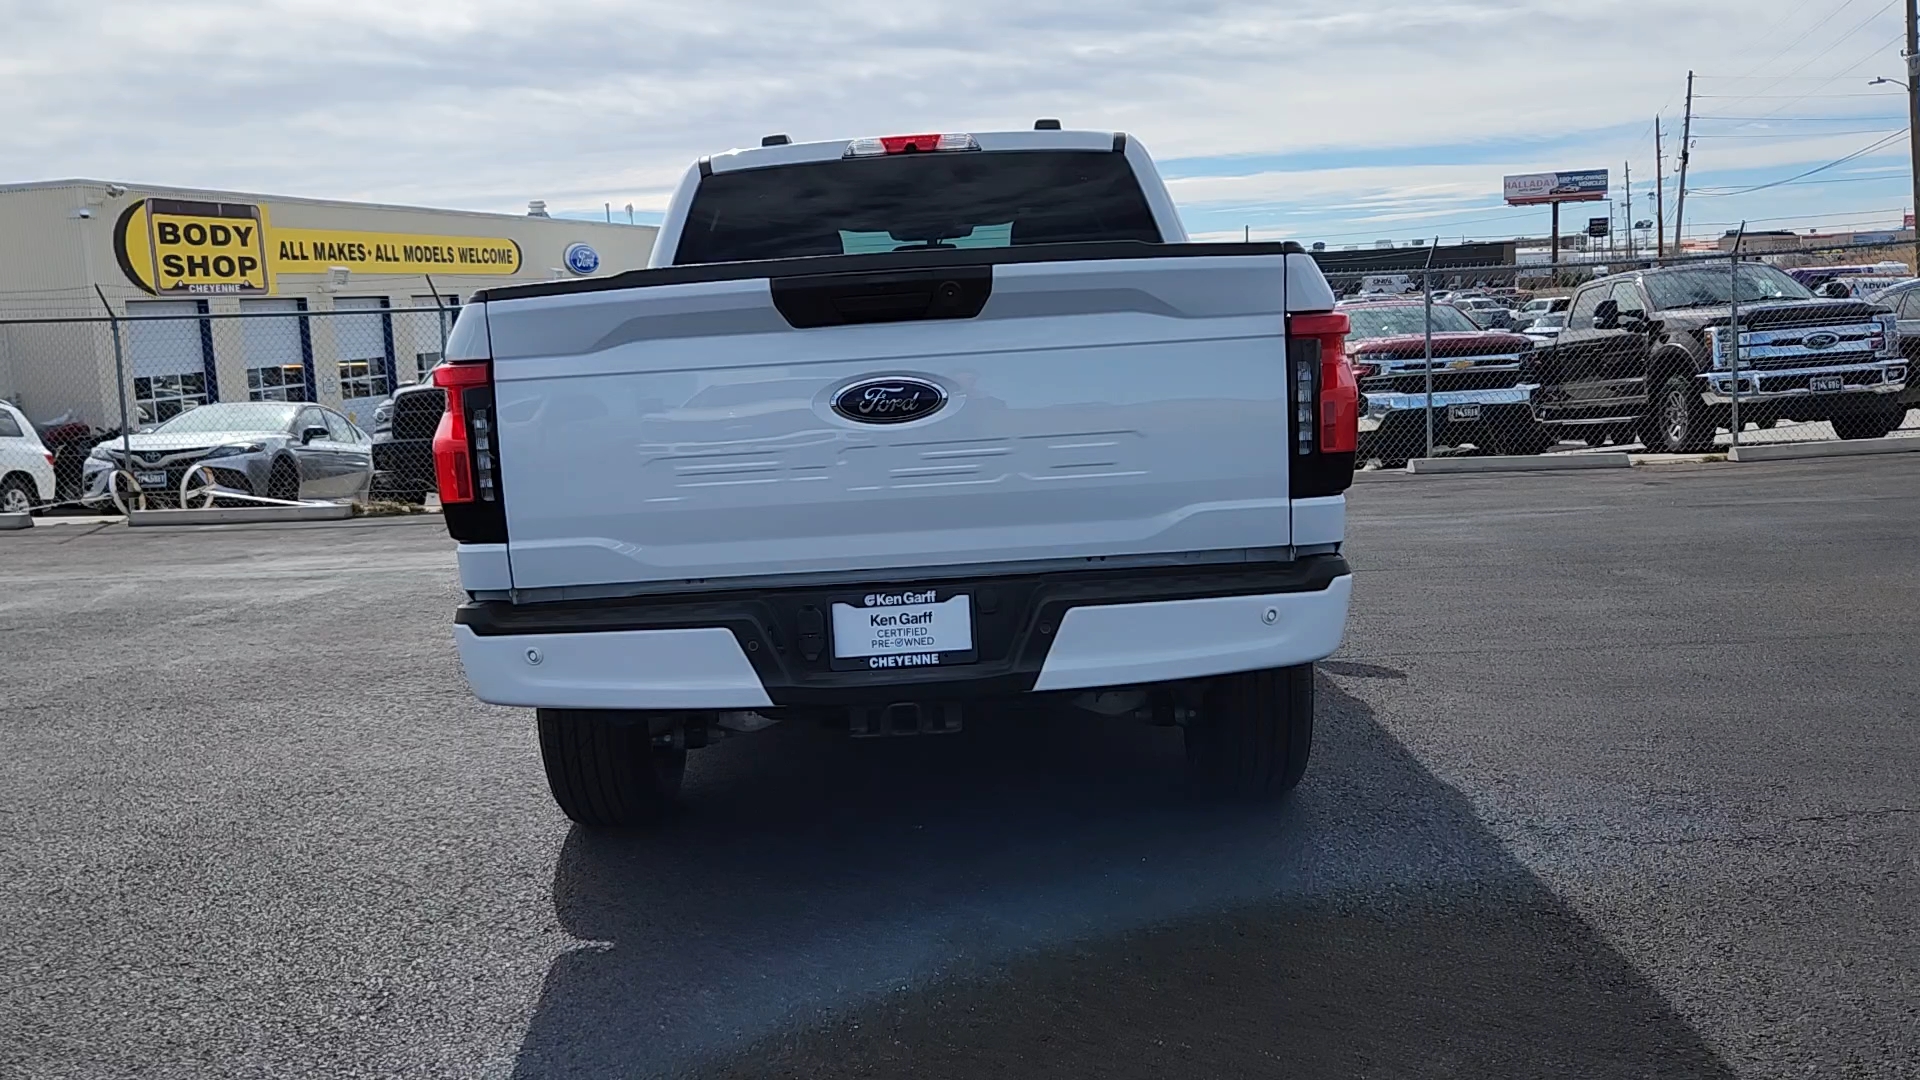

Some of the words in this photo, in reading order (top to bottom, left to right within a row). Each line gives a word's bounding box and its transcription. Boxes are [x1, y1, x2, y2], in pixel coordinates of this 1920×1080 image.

[1505, 178, 1556, 189] HALLADAY
[158, 222, 253, 247] BODY
[279, 241, 309, 261] ALL
[313, 242, 366, 262] MAKES
[375, 244, 400, 262] ALL
[403, 244, 455, 263] MODELS
[457, 246, 514, 265] WELCOME
[576, 250, 595, 268] Ford
[163, 254, 258, 278] SHOP
[188, 284, 241, 293] CHEYENNE
[858, 386, 919, 414] Ford
[876, 593, 902, 606] Ken
[903, 590, 937, 604] Garff
[870, 614, 897, 627] Ken
[899, 611, 933, 625] Garff
[876, 627, 928, 638] CERTIFIED
[871, 636, 935, 648] PRE-OWNED
[869, 653, 940, 668] CHEYENNE
